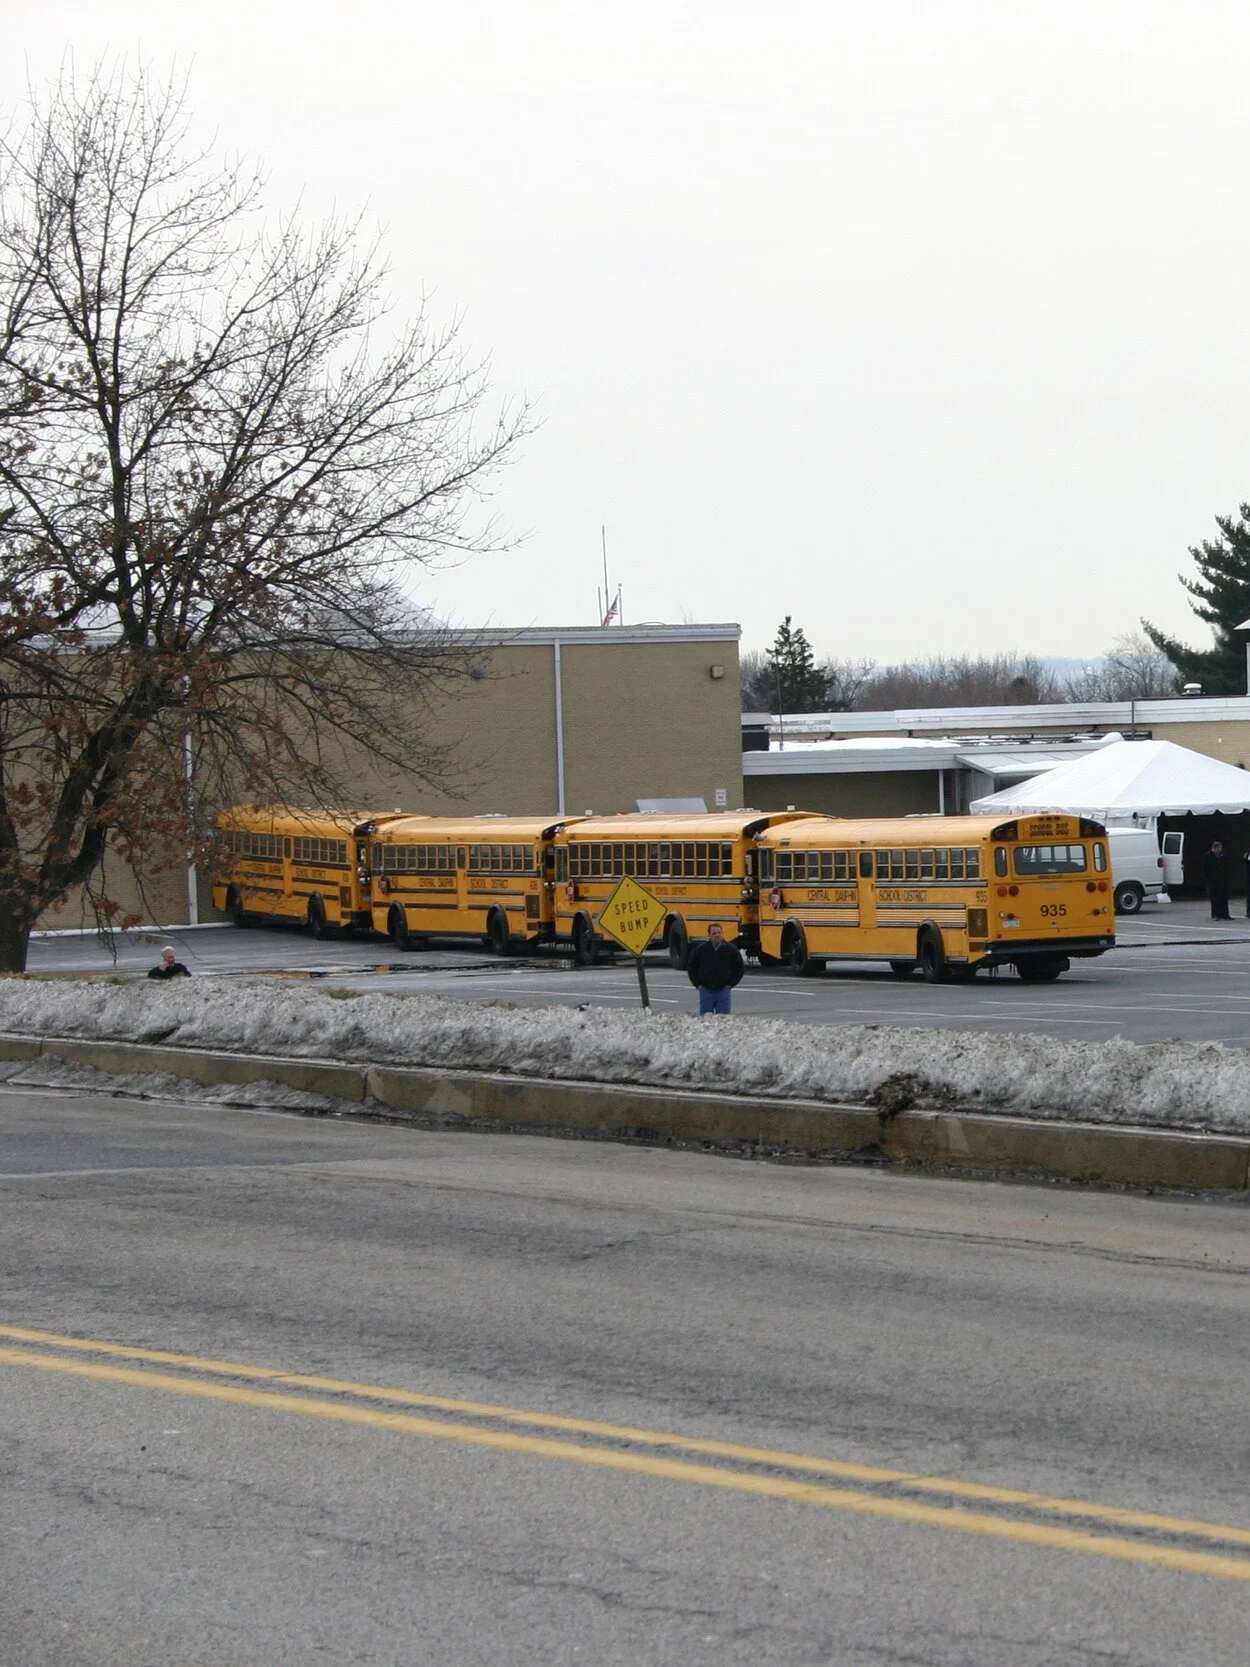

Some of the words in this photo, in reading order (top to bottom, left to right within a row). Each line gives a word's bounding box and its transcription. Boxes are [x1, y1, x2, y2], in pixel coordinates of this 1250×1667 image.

[470, 878, 487, 888] SCHOOL
[491, 879, 508, 889] DISTRICT
[807, 889, 832, 902] CENTRAL
[834, 889, 857, 902] DAUPHIN
[878, 889, 902, 902] SCHOOL
[904, 889, 928, 902] DISTRICT
[975, 890, 988, 903] 935
[615, 899, 648, 915] SPEED
[1040, 904, 1067, 917] 935
[619, 917, 649, 933] BUMP
